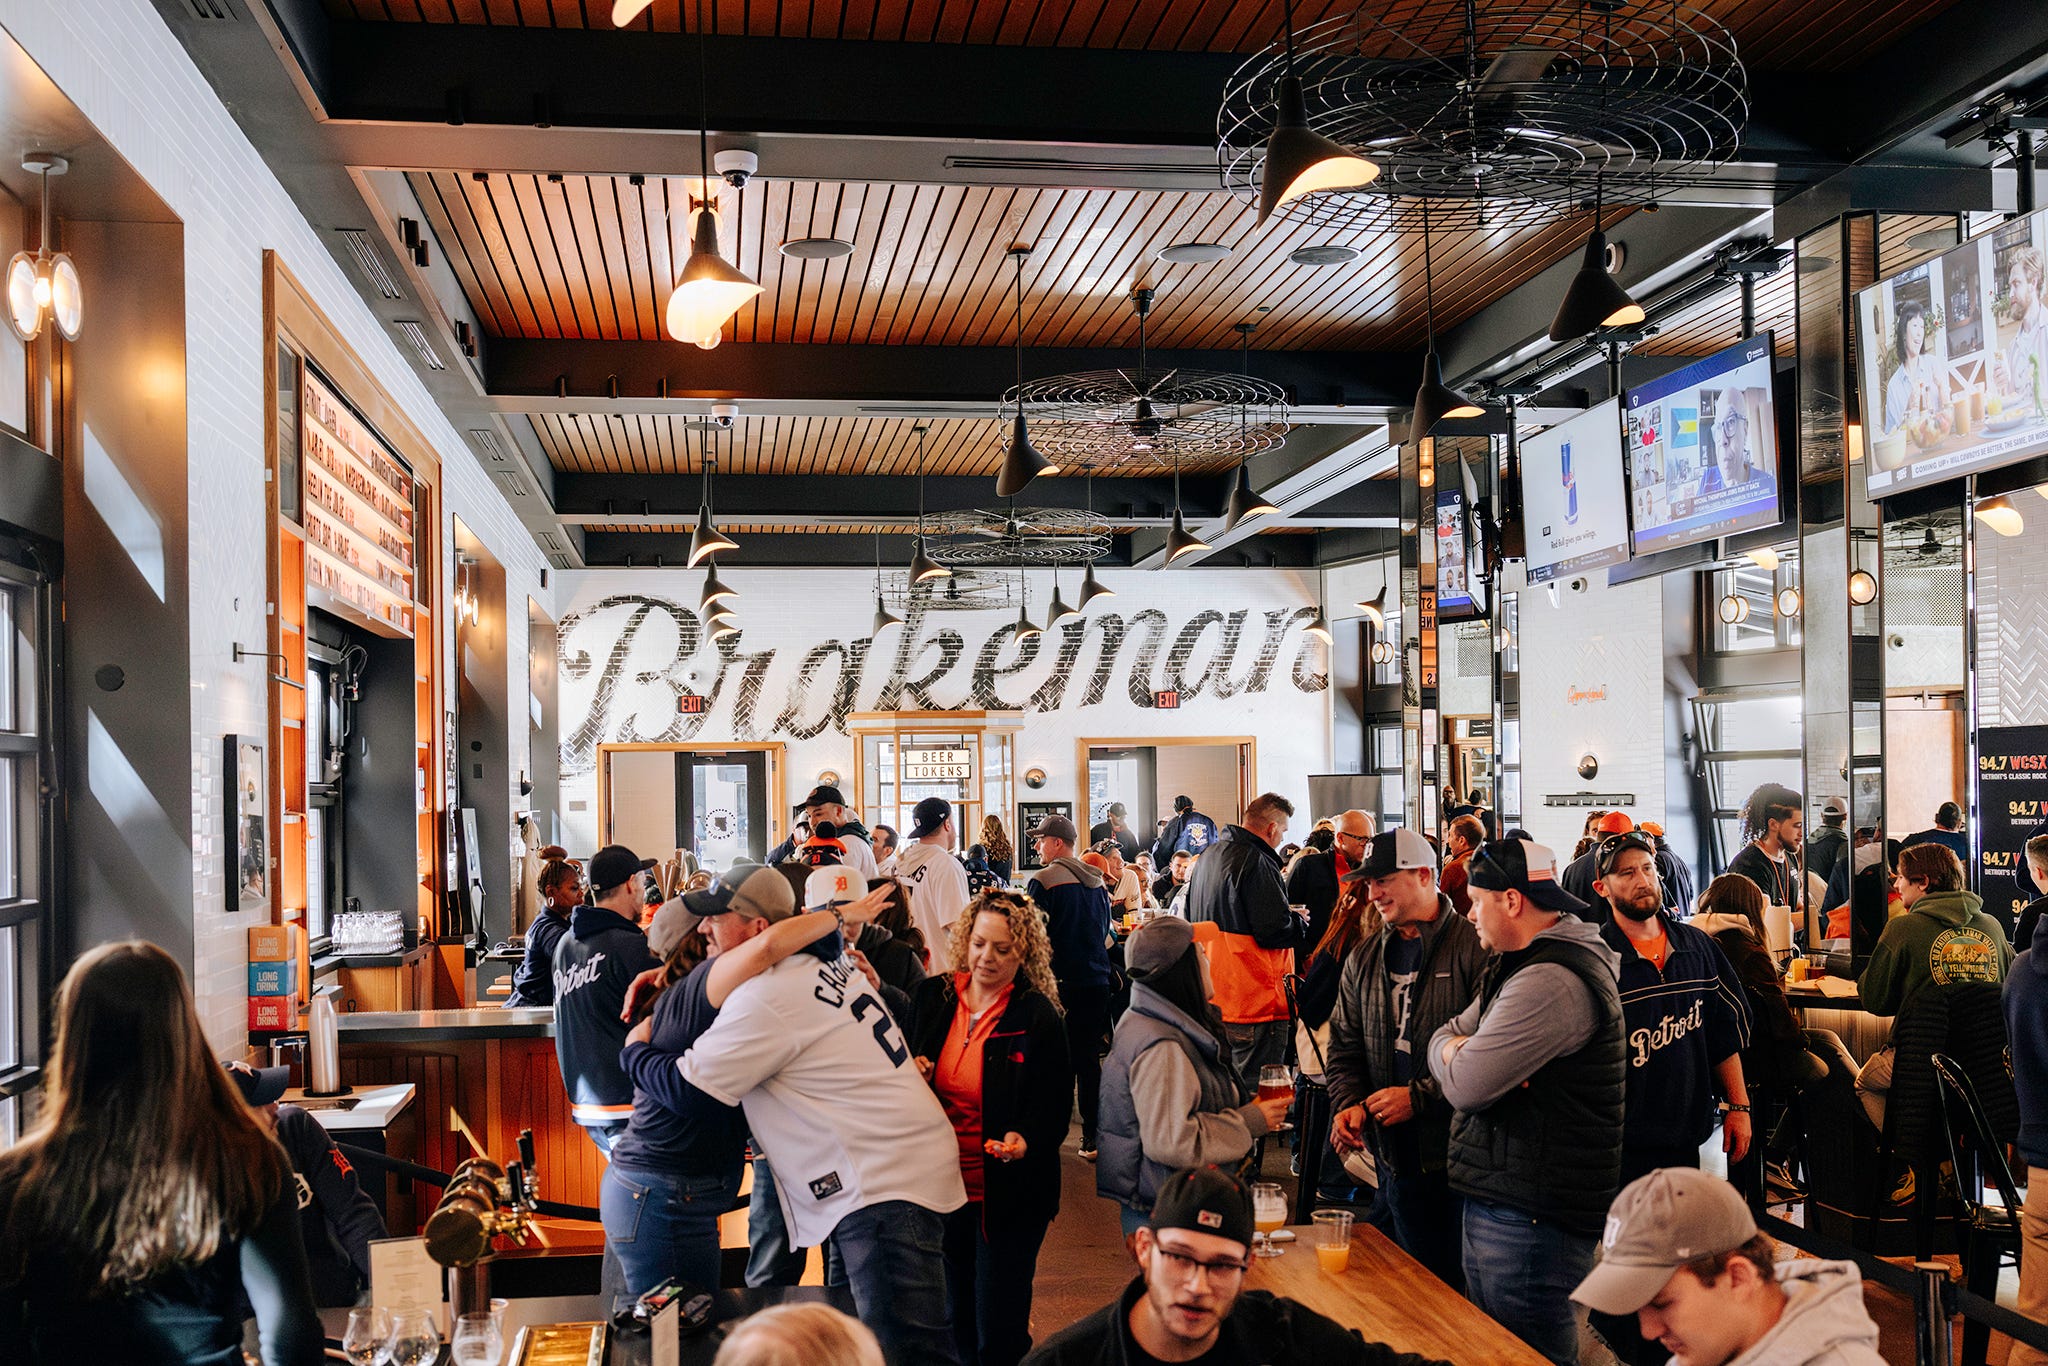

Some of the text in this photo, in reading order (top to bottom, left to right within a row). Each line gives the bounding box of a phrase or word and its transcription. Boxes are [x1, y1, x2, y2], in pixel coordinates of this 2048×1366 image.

[1915, 462, 1938, 474] COMING
[2004, 441, 2013, 449] THE
[556, 576, 1328, 780] Brakeman
[681, 696, 701, 712] EXIT
[1158, 692, 1178, 708] EXIT
[922, 752, 953, 763] BEER
[1979, 755, 2047, 770] 94.7 WCSX
[914, 766, 963, 777] TOKENS
[2008, 801, 2038, 816] 94.7
[2011, 818, 2038, 826] DETROIT'S
[1982, 851, 2010, 866] 94.7
[1984, 868, 2011, 876] DETROIT'S
[257, 937, 278, 947] LONG
[256, 947, 279, 957] DRINK
[1948, 963, 1985, 973] YELLOWSTONE
[258, 972, 278, 982] LONG
[553, 952, 606, 1005] Detroit
[256, 982, 279, 992] DRINK
[257, 1006, 278, 1016] LONG
[256, 1016, 279, 1026] DRINK
[1629, 998, 1703, 1068] Detroit
